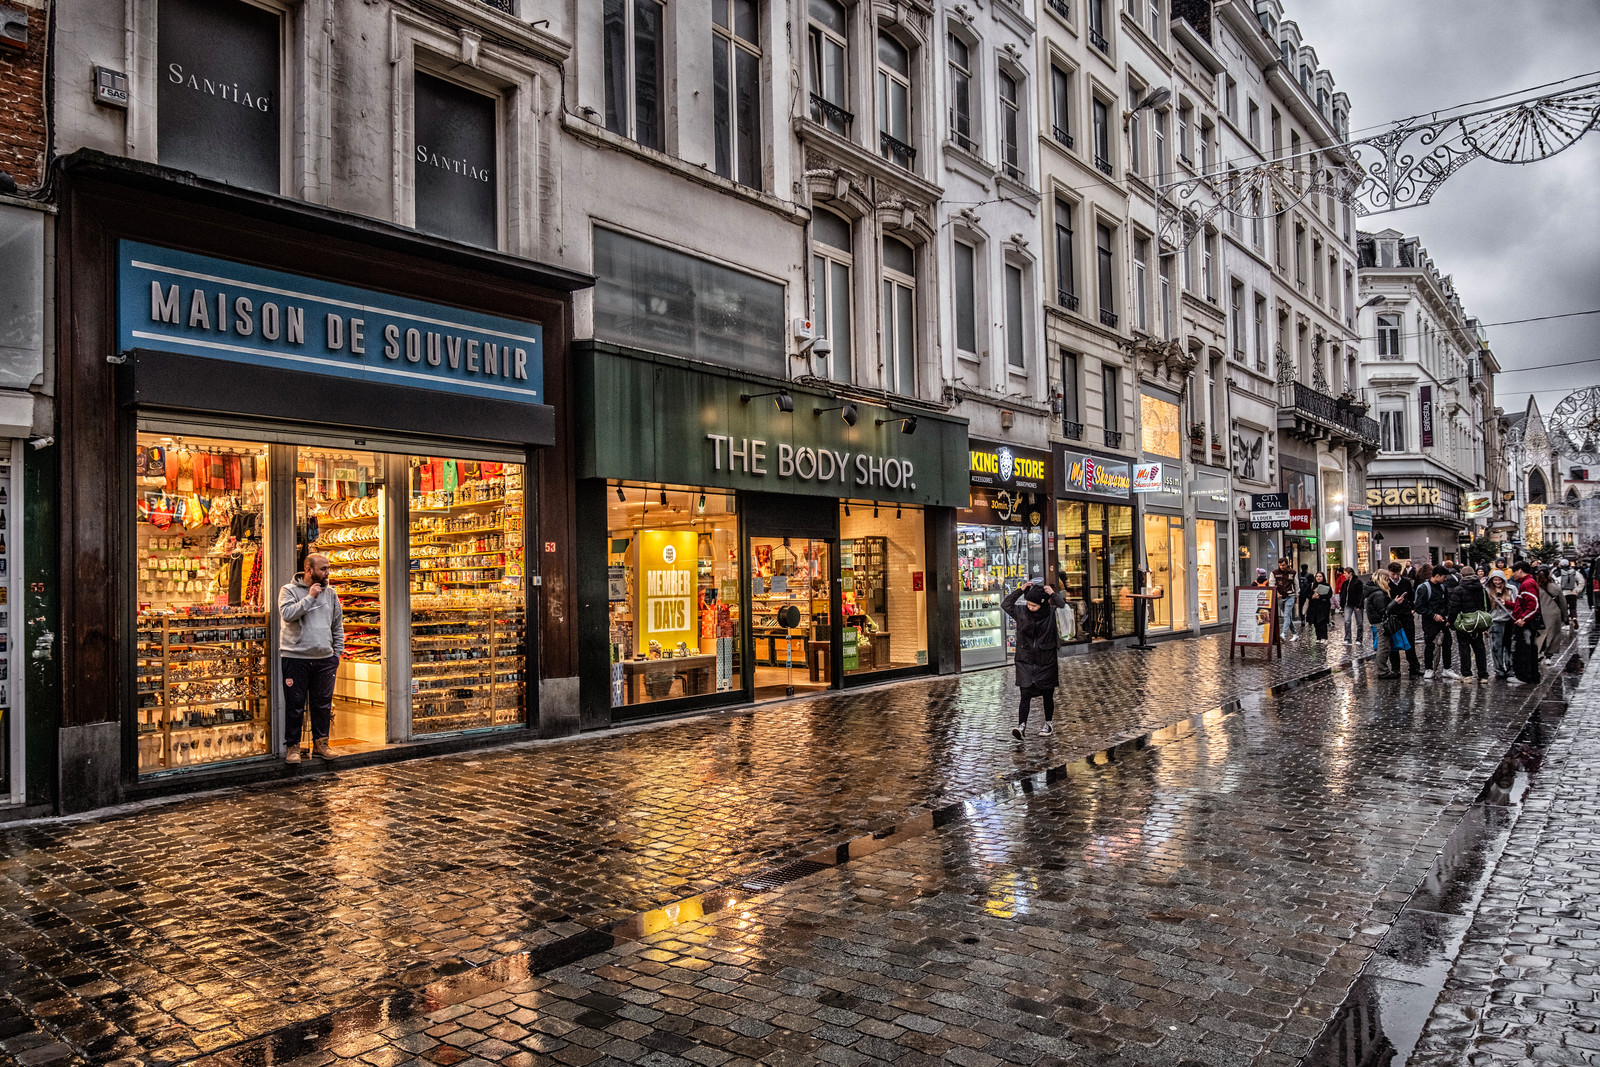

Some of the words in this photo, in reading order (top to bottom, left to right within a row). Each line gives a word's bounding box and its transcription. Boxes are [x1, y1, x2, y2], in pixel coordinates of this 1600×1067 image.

[107, 88, 126, 100] SAS
[151, 281, 305, 344] MAISON
[327, 313, 365, 354] DE
[384, 324, 528, 381] SOUVENIR
[707, 433, 768, 474] THE
[778, 443, 850, 482] BODY
[970, 450, 999, 474] KING
[1013, 457, 1045, 480] STORE
[1069, 461, 1083, 486] My
[1095, 464, 1131, 490] Shawarma
[1136, 468, 1150, 481] My
[1366, 483, 1441, 506] sacha
[1261, 521, 1271, 529] 892
[545, 542, 556, 553] 53
[30, 582, 45, 593] 55
[647, 570, 691, 597] MEMBER
[653, 599, 685, 630] DAYS
